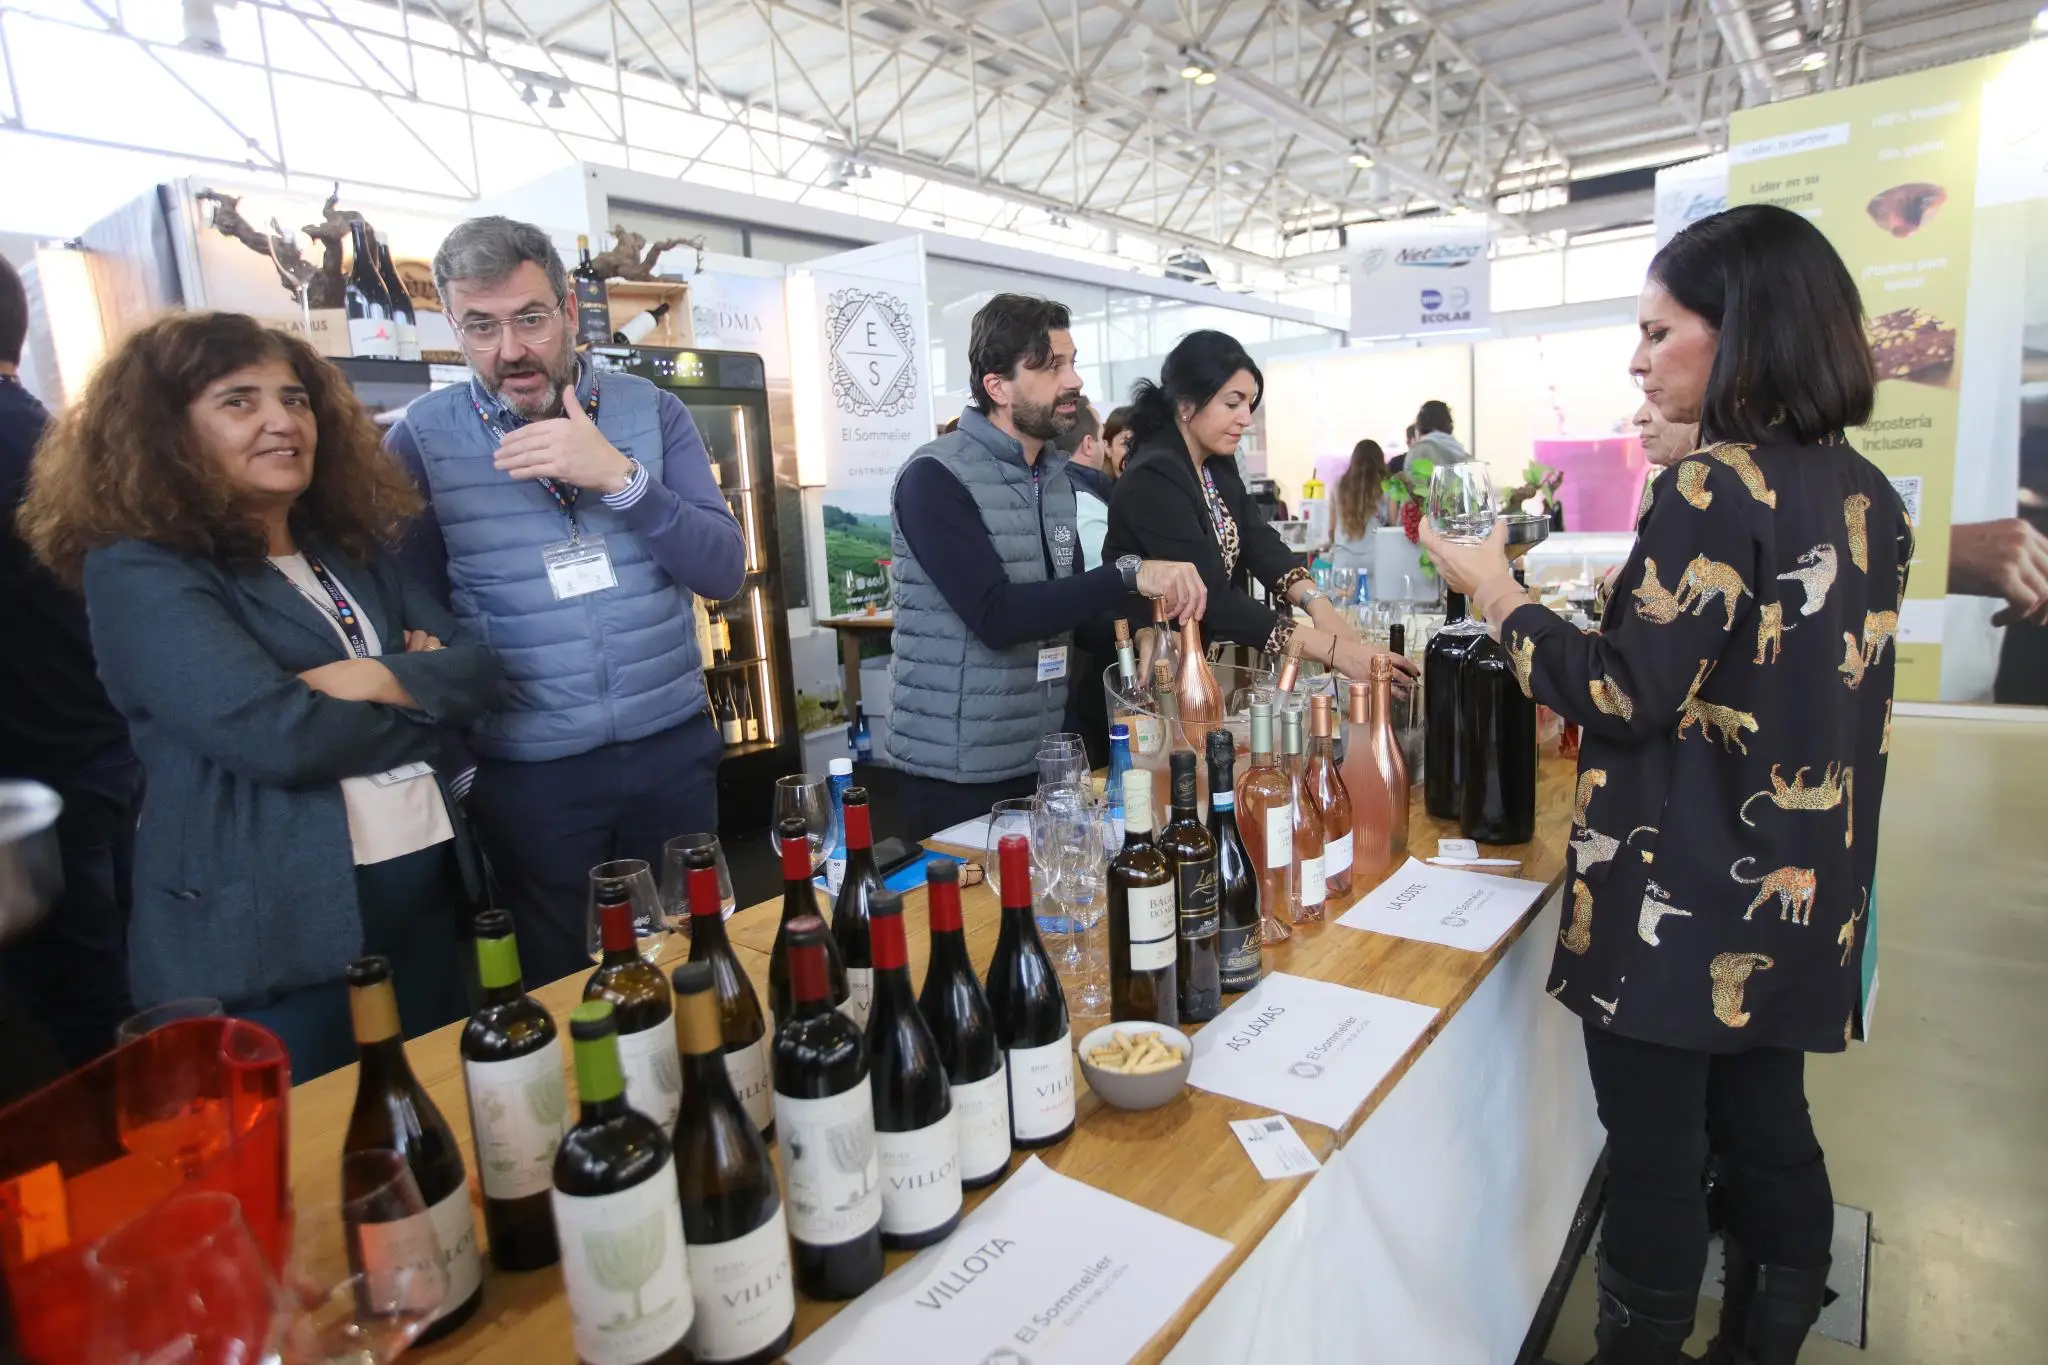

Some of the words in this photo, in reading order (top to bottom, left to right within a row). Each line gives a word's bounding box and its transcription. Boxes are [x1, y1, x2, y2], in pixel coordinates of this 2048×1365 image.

[1421, 311, 1471, 324] ECOLAB
[866, 322, 877, 347] E
[869, 361, 881, 386] S
[842, 428, 852, 441] El
[855, 428, 912, 442] Sommelier
[1862, 436, 1923, 451] Inclusiva
[1399, 883, 1428, 903] COSTE
[1225, 1036, 1251, 1051] AS
[1248, 1005, 1286, 1037] LAXAS
[1315, 1016, 1360, 1053] Sommelier
[914, 1237, 1017, 1311] VILLOTA
[1013, 1324, 1038, 1345] El
[1031, 1254, 1114, 1327] Sommelier
